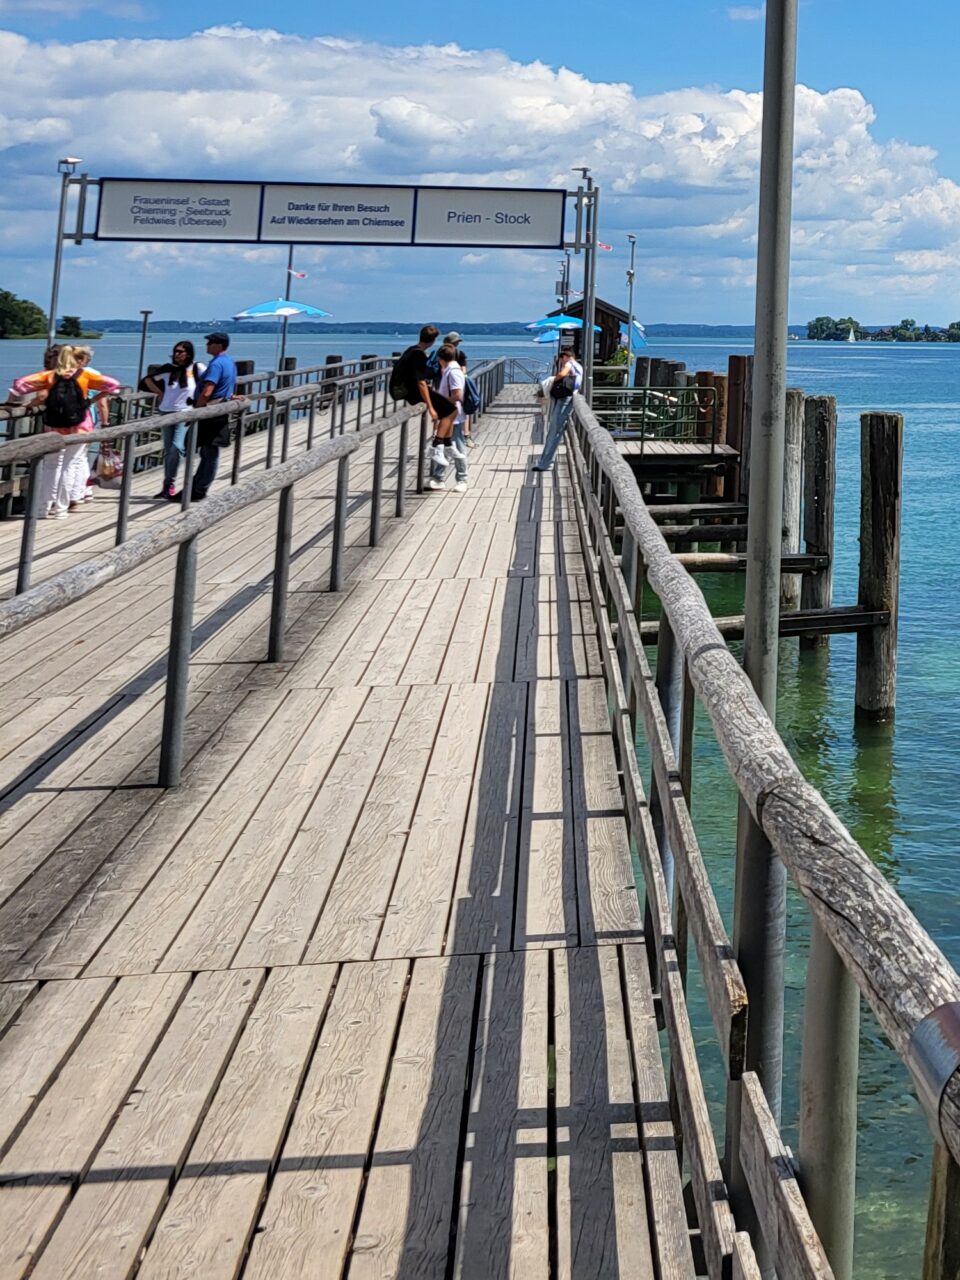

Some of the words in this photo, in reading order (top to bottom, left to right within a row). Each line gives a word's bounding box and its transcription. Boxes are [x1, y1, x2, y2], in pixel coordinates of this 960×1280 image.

[133, 195, 190, 205] Fraueninsel
[198, 197, 231, 206] Gstadt
[130, 206, 177, 216] Chieming
[185, 207, 232, 216] Seebruck
[287, 202, 316, 211] Danke
[318, 202, 330, 211] für
[332, 203, 354, 212] Ihren
[357, 204, 390, 213] Besuch
[133, 216, 176, 225] Feldwies
[178, 216, 227, 227] (Übersee)
[270, 216, 286, 225] Auf
[287, 216, 344, 225] Wiedersehen
[362, 217, 405, 227] Chiemsee
[447, 211, 481, 223] Prien
[494, 212, 531, 224] Stock
